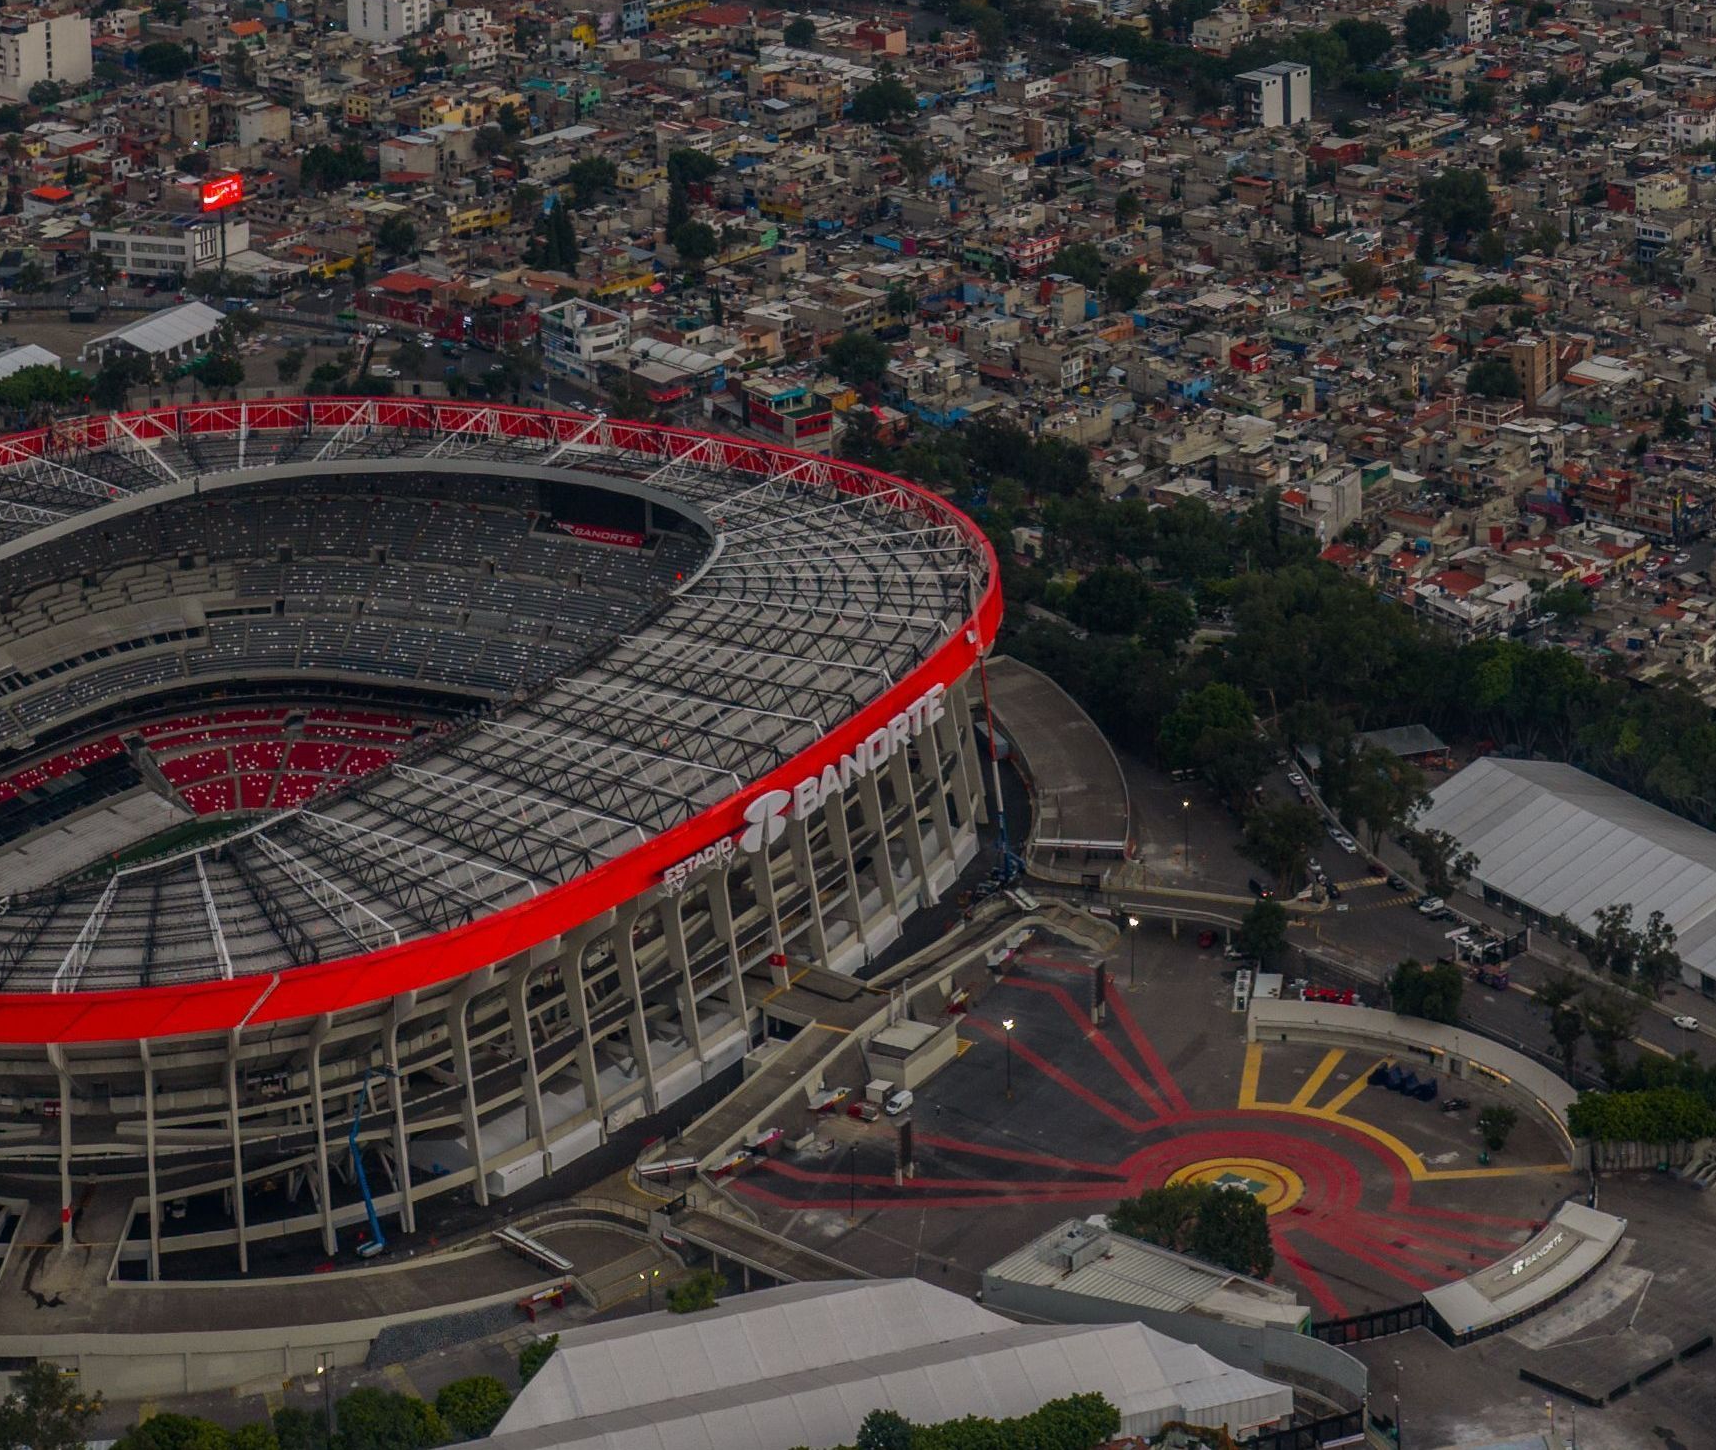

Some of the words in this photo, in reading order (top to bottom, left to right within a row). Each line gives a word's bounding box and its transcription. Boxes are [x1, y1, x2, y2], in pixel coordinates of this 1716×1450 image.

[575, 528, 635, 544] BANORTE
[663, 836, 732, 884] ESTADIO
[794, 682, 945, 821] BANORTE
[1525, 1232, 1563, 1267] BANORTE
